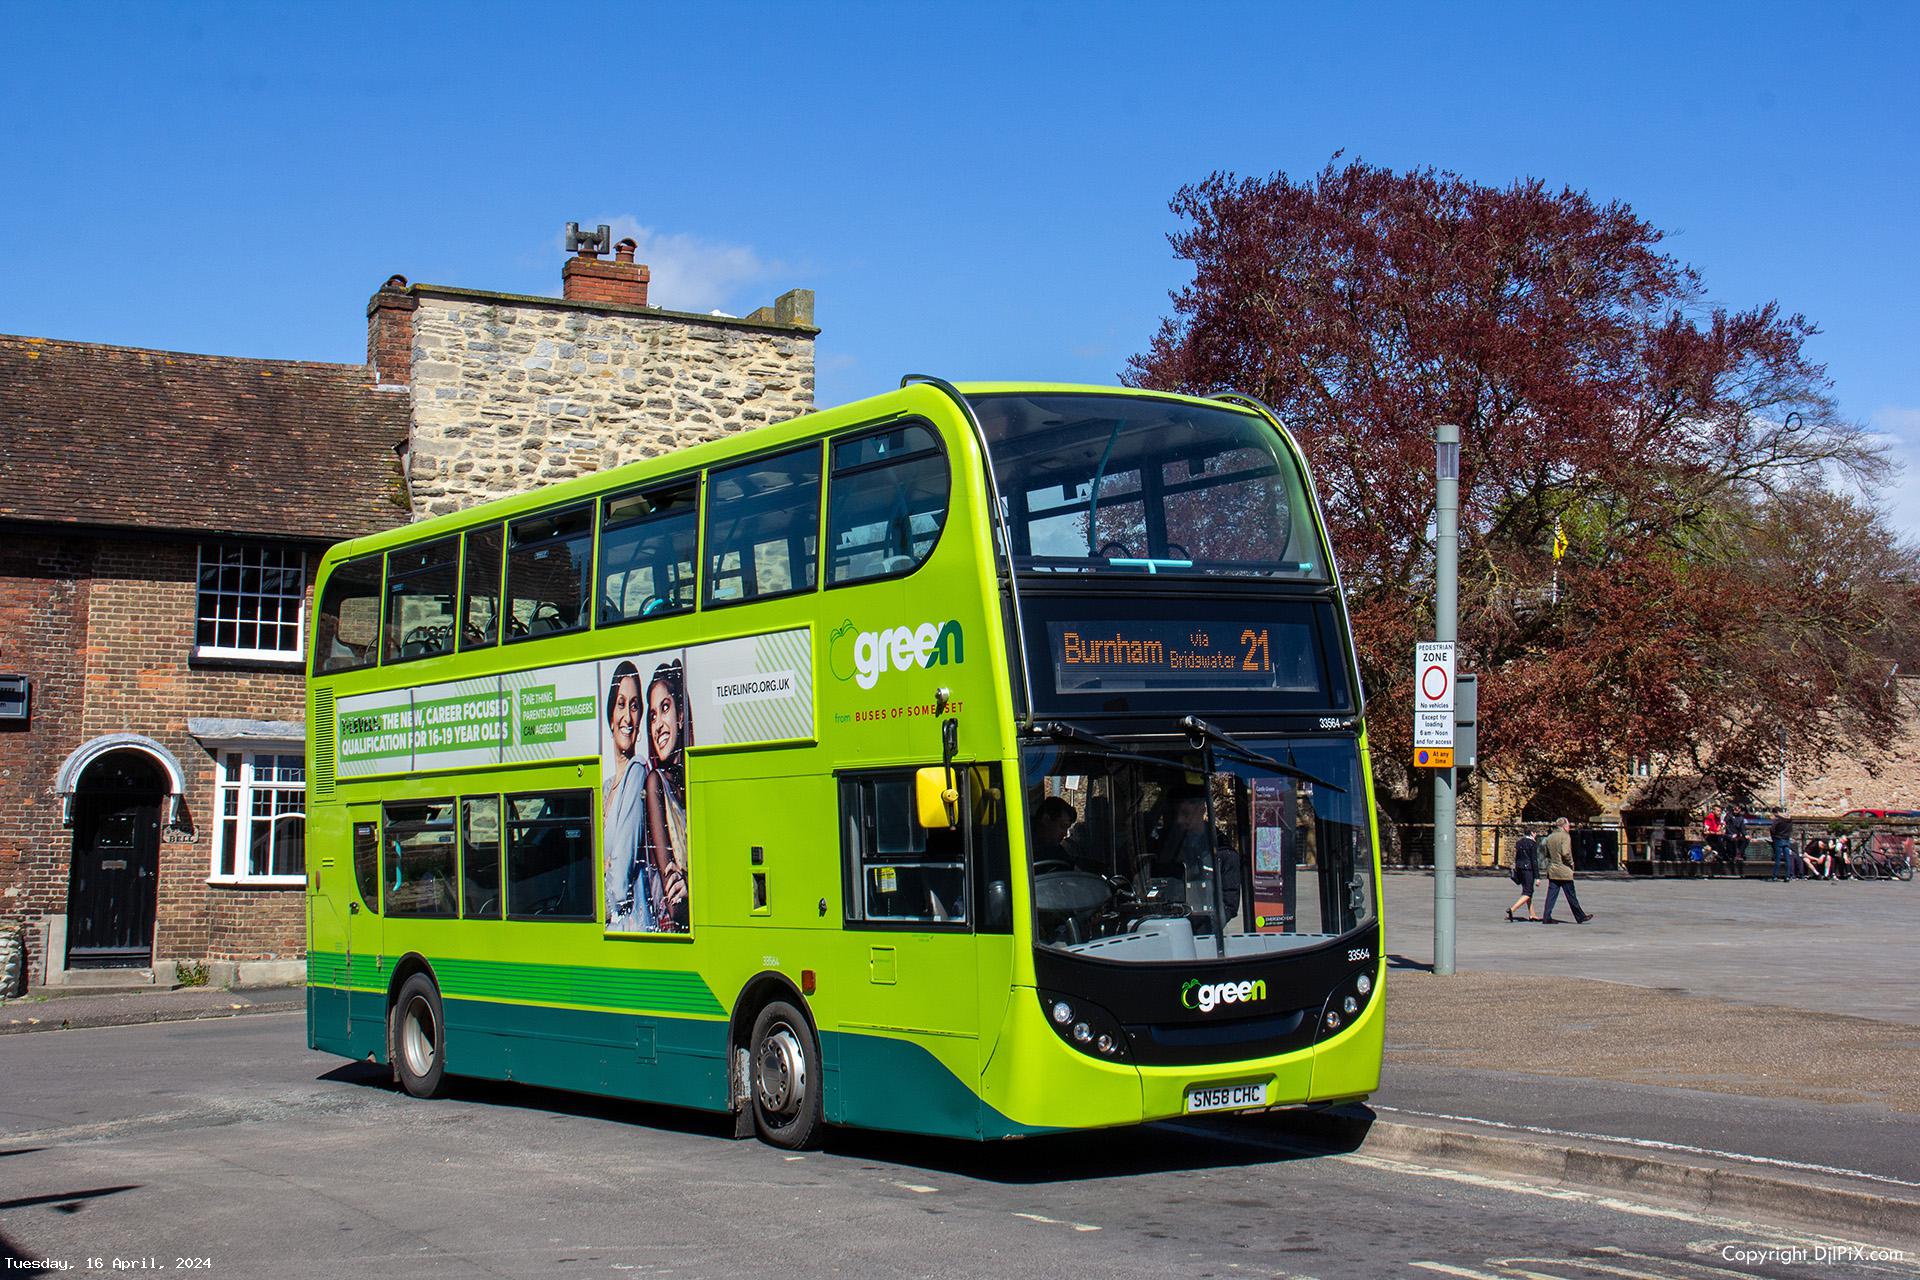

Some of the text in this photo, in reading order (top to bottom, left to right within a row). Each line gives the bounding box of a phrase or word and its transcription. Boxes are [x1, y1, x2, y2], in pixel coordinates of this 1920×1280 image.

[1063, 632, 1163, 664] Burnham
[1190, 630, 1209, 647] via
[854, 619, 964, 689] green
[1240, 629, 1270, 671] 21
[1423, 652, 1448, 662] ZONE
[716, 678, 790, 698] TLEVELINFO.ORG.UK
[522, 692, 552, 705] ONE THING
[382, 712, 400, 730] THE
[426, 704, 462, 724] CAREER
[463, 698, 509, 720] FOCUSED
[523, 702, 594, 720] PARENTS AND TEENAGERS
[855, 709, 887, 721] BUSES
[891, 707, 903, 718] OF
[907, 702, 963, 716] SOMESET
[523, 722, 563, 736] CAN AGREE ON
[1319, 717, 1340, 729] 33564
[342, 721, 508, 755] QUALIFICATION FOR 16-19 YEAR OLDS
[1348, 948, 1370, 961] 33564
[1197, 979, 1267, 1012] green
[1194, 1086, 1260, 1107] SN58 CHC
